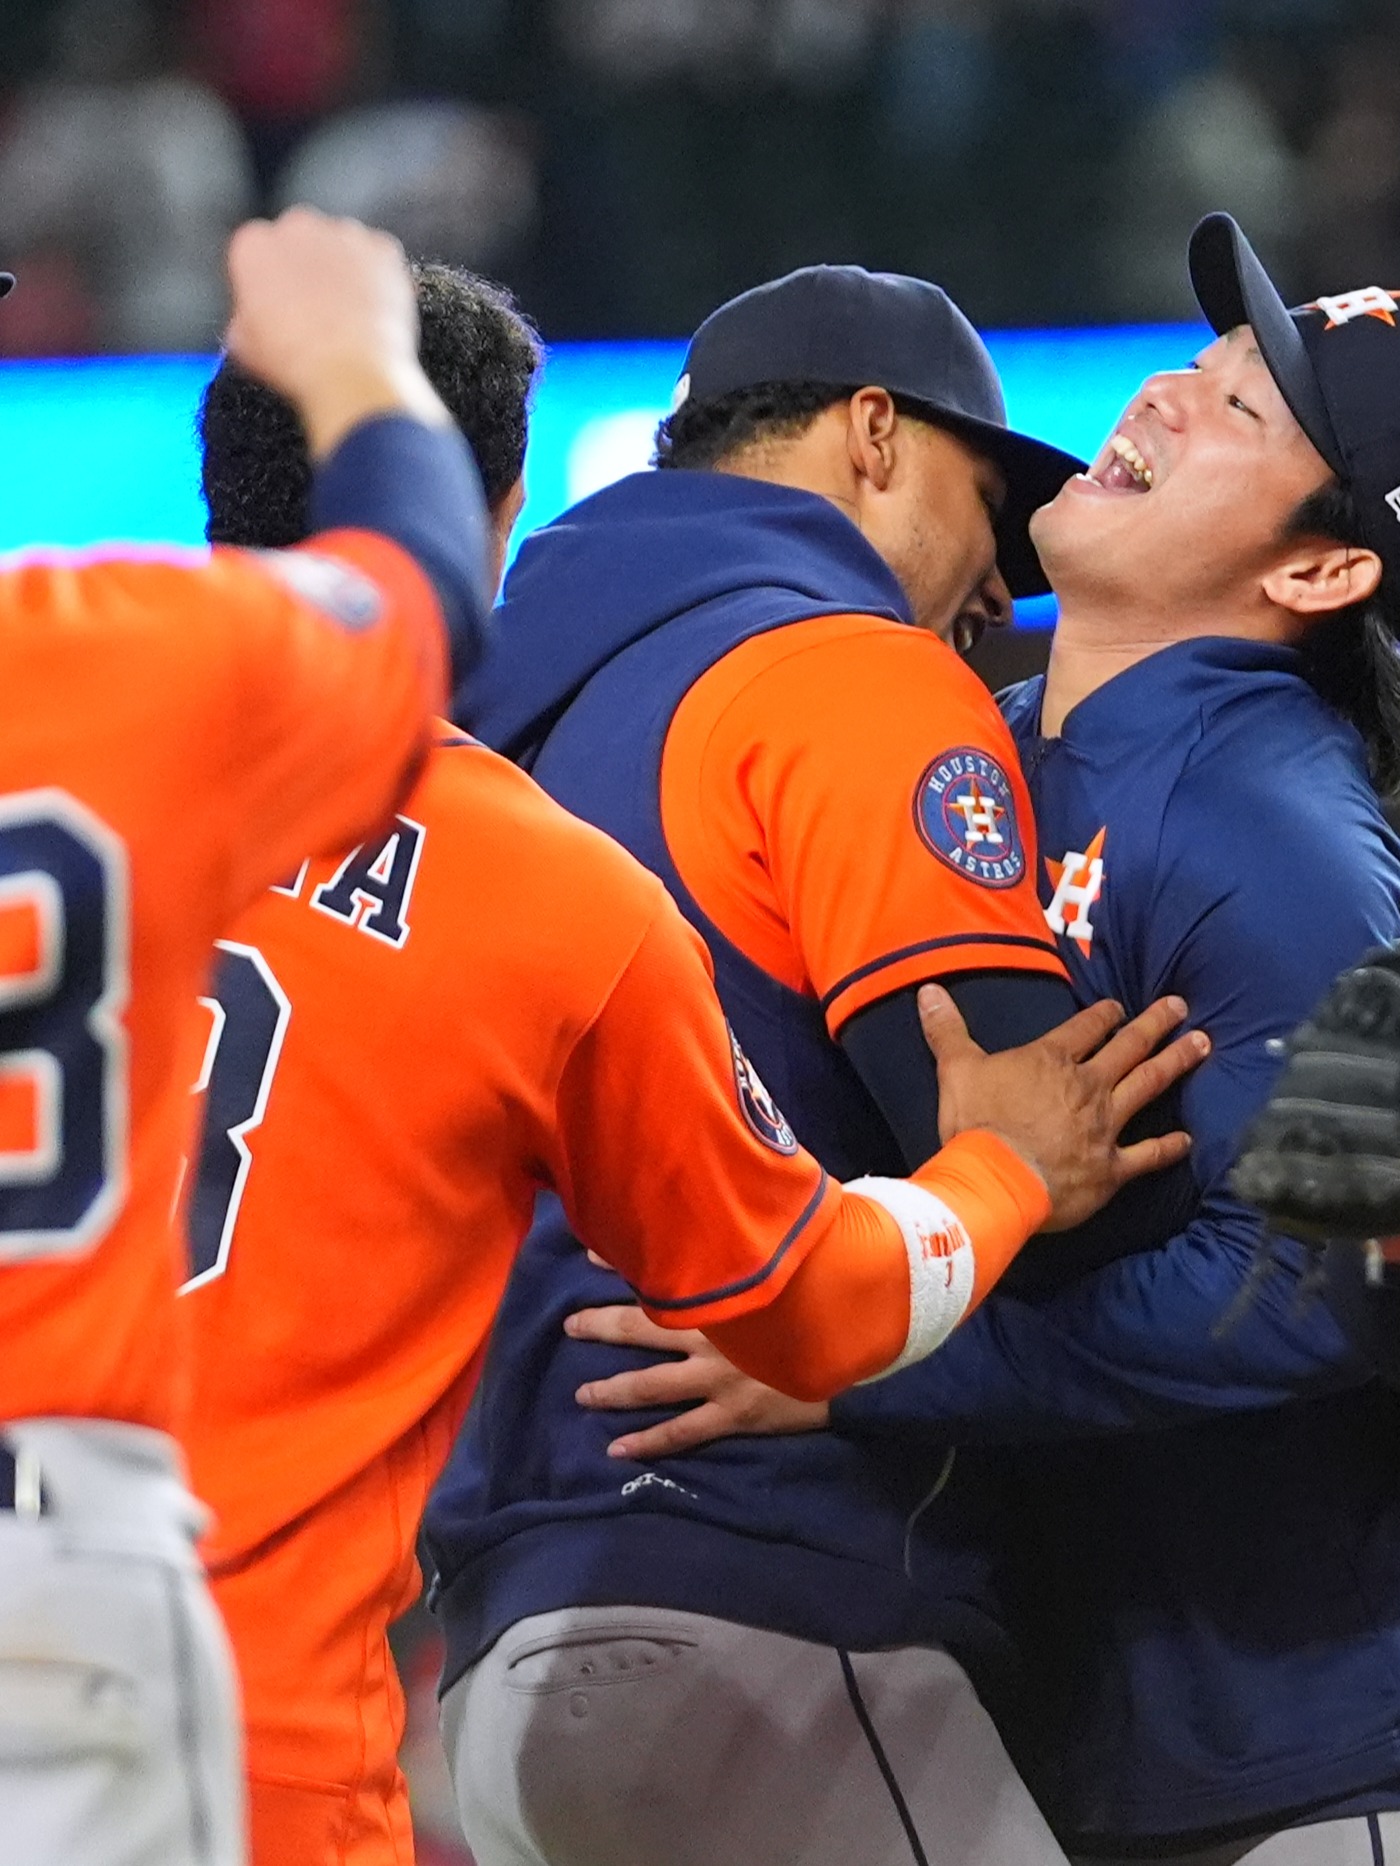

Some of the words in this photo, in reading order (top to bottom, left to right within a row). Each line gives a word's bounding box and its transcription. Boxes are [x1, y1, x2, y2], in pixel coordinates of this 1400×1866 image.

[928, 755, 1010, 796] HOUSTON
[957, 795, 1003, 843] H
[270, 813, 427, 949] A
[950, 846, 1022, 879] ASTROS
[1043, 850, 1103, 941] H
